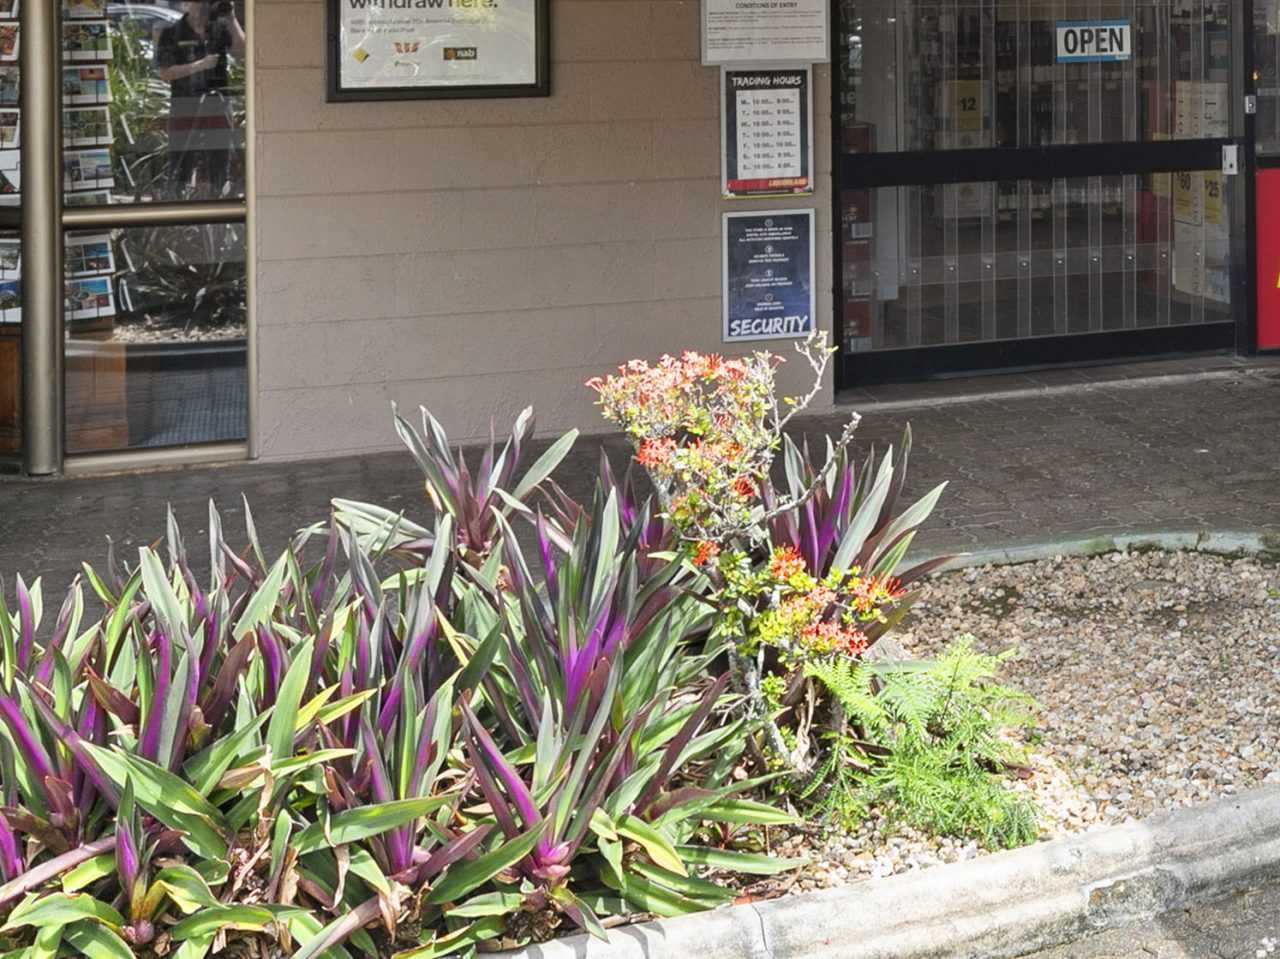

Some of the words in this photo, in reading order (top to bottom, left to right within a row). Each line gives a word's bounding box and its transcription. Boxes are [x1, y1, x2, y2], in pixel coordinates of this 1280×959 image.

[1063, 27, 1124, 55] OPEN
[731, 77, 771, 87] TRADING
[773, 76, 803, 86] HOURS
[730, 315, 809, 336] SECURITY
